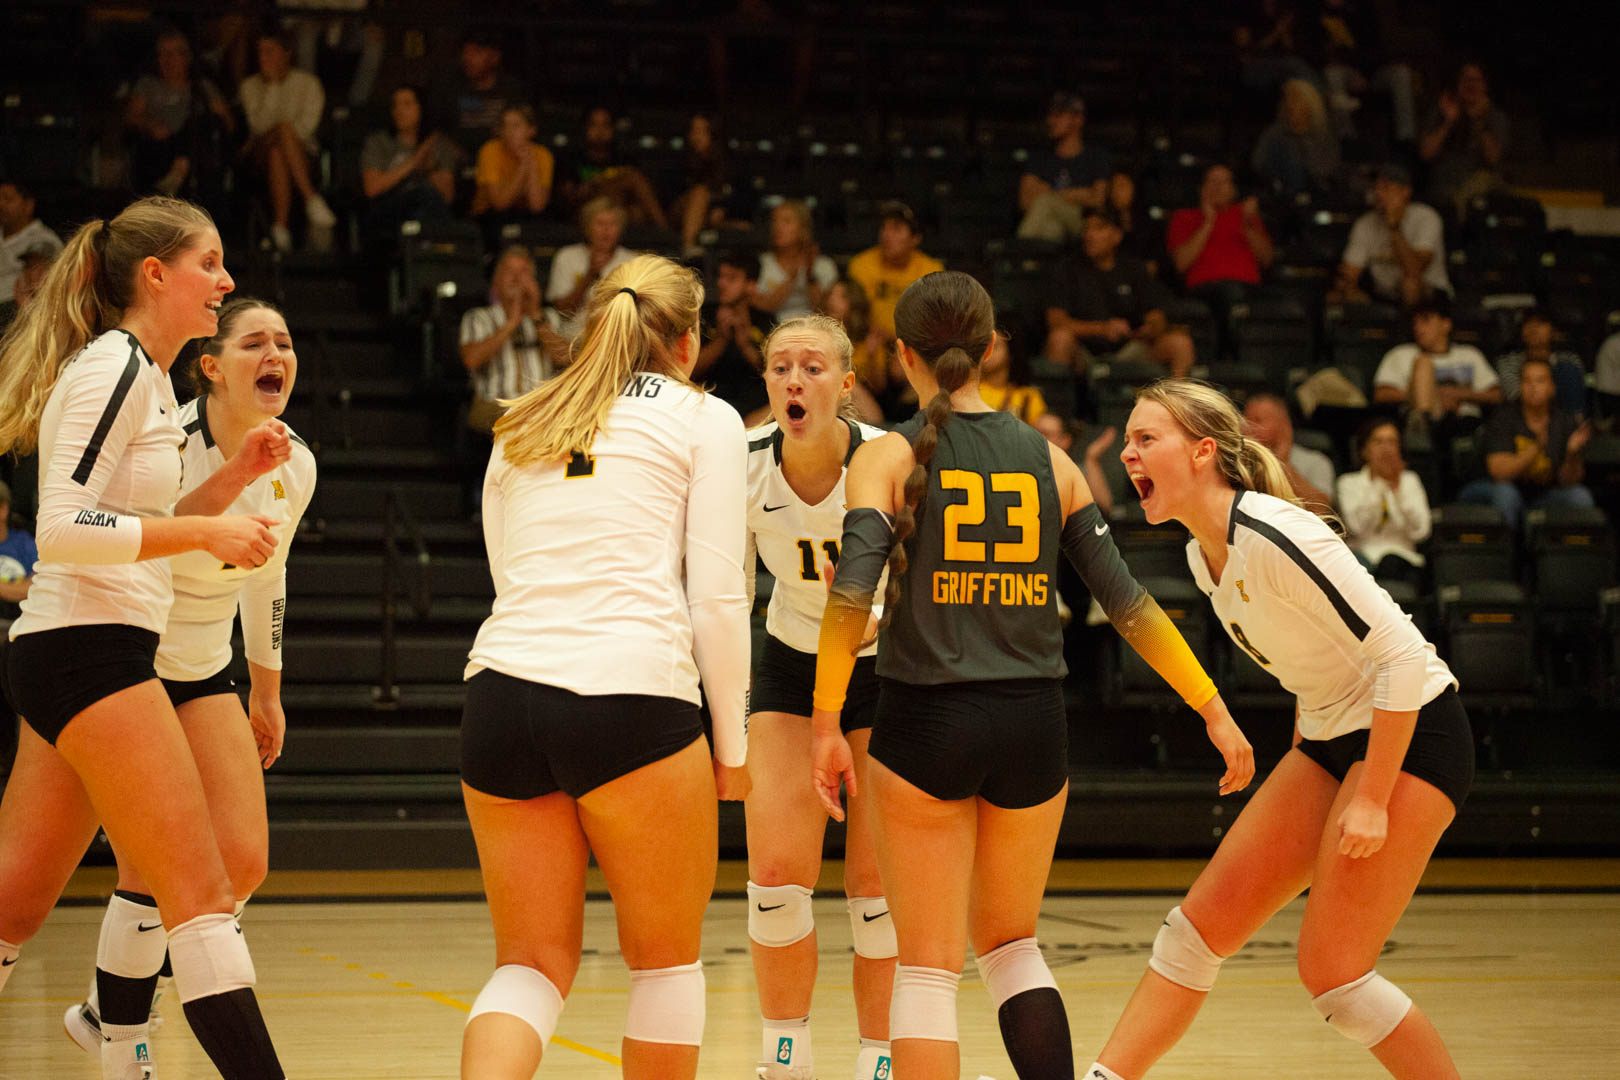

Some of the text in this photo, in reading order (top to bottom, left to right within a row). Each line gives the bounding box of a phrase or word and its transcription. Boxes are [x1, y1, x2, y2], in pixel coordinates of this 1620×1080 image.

[74, 510, 118, 528] MWSU
[939, 469, 1041, 563] 23
[796, 538, 841, 582] 11
[932, 570, 1049, 606] GRIFFONS
